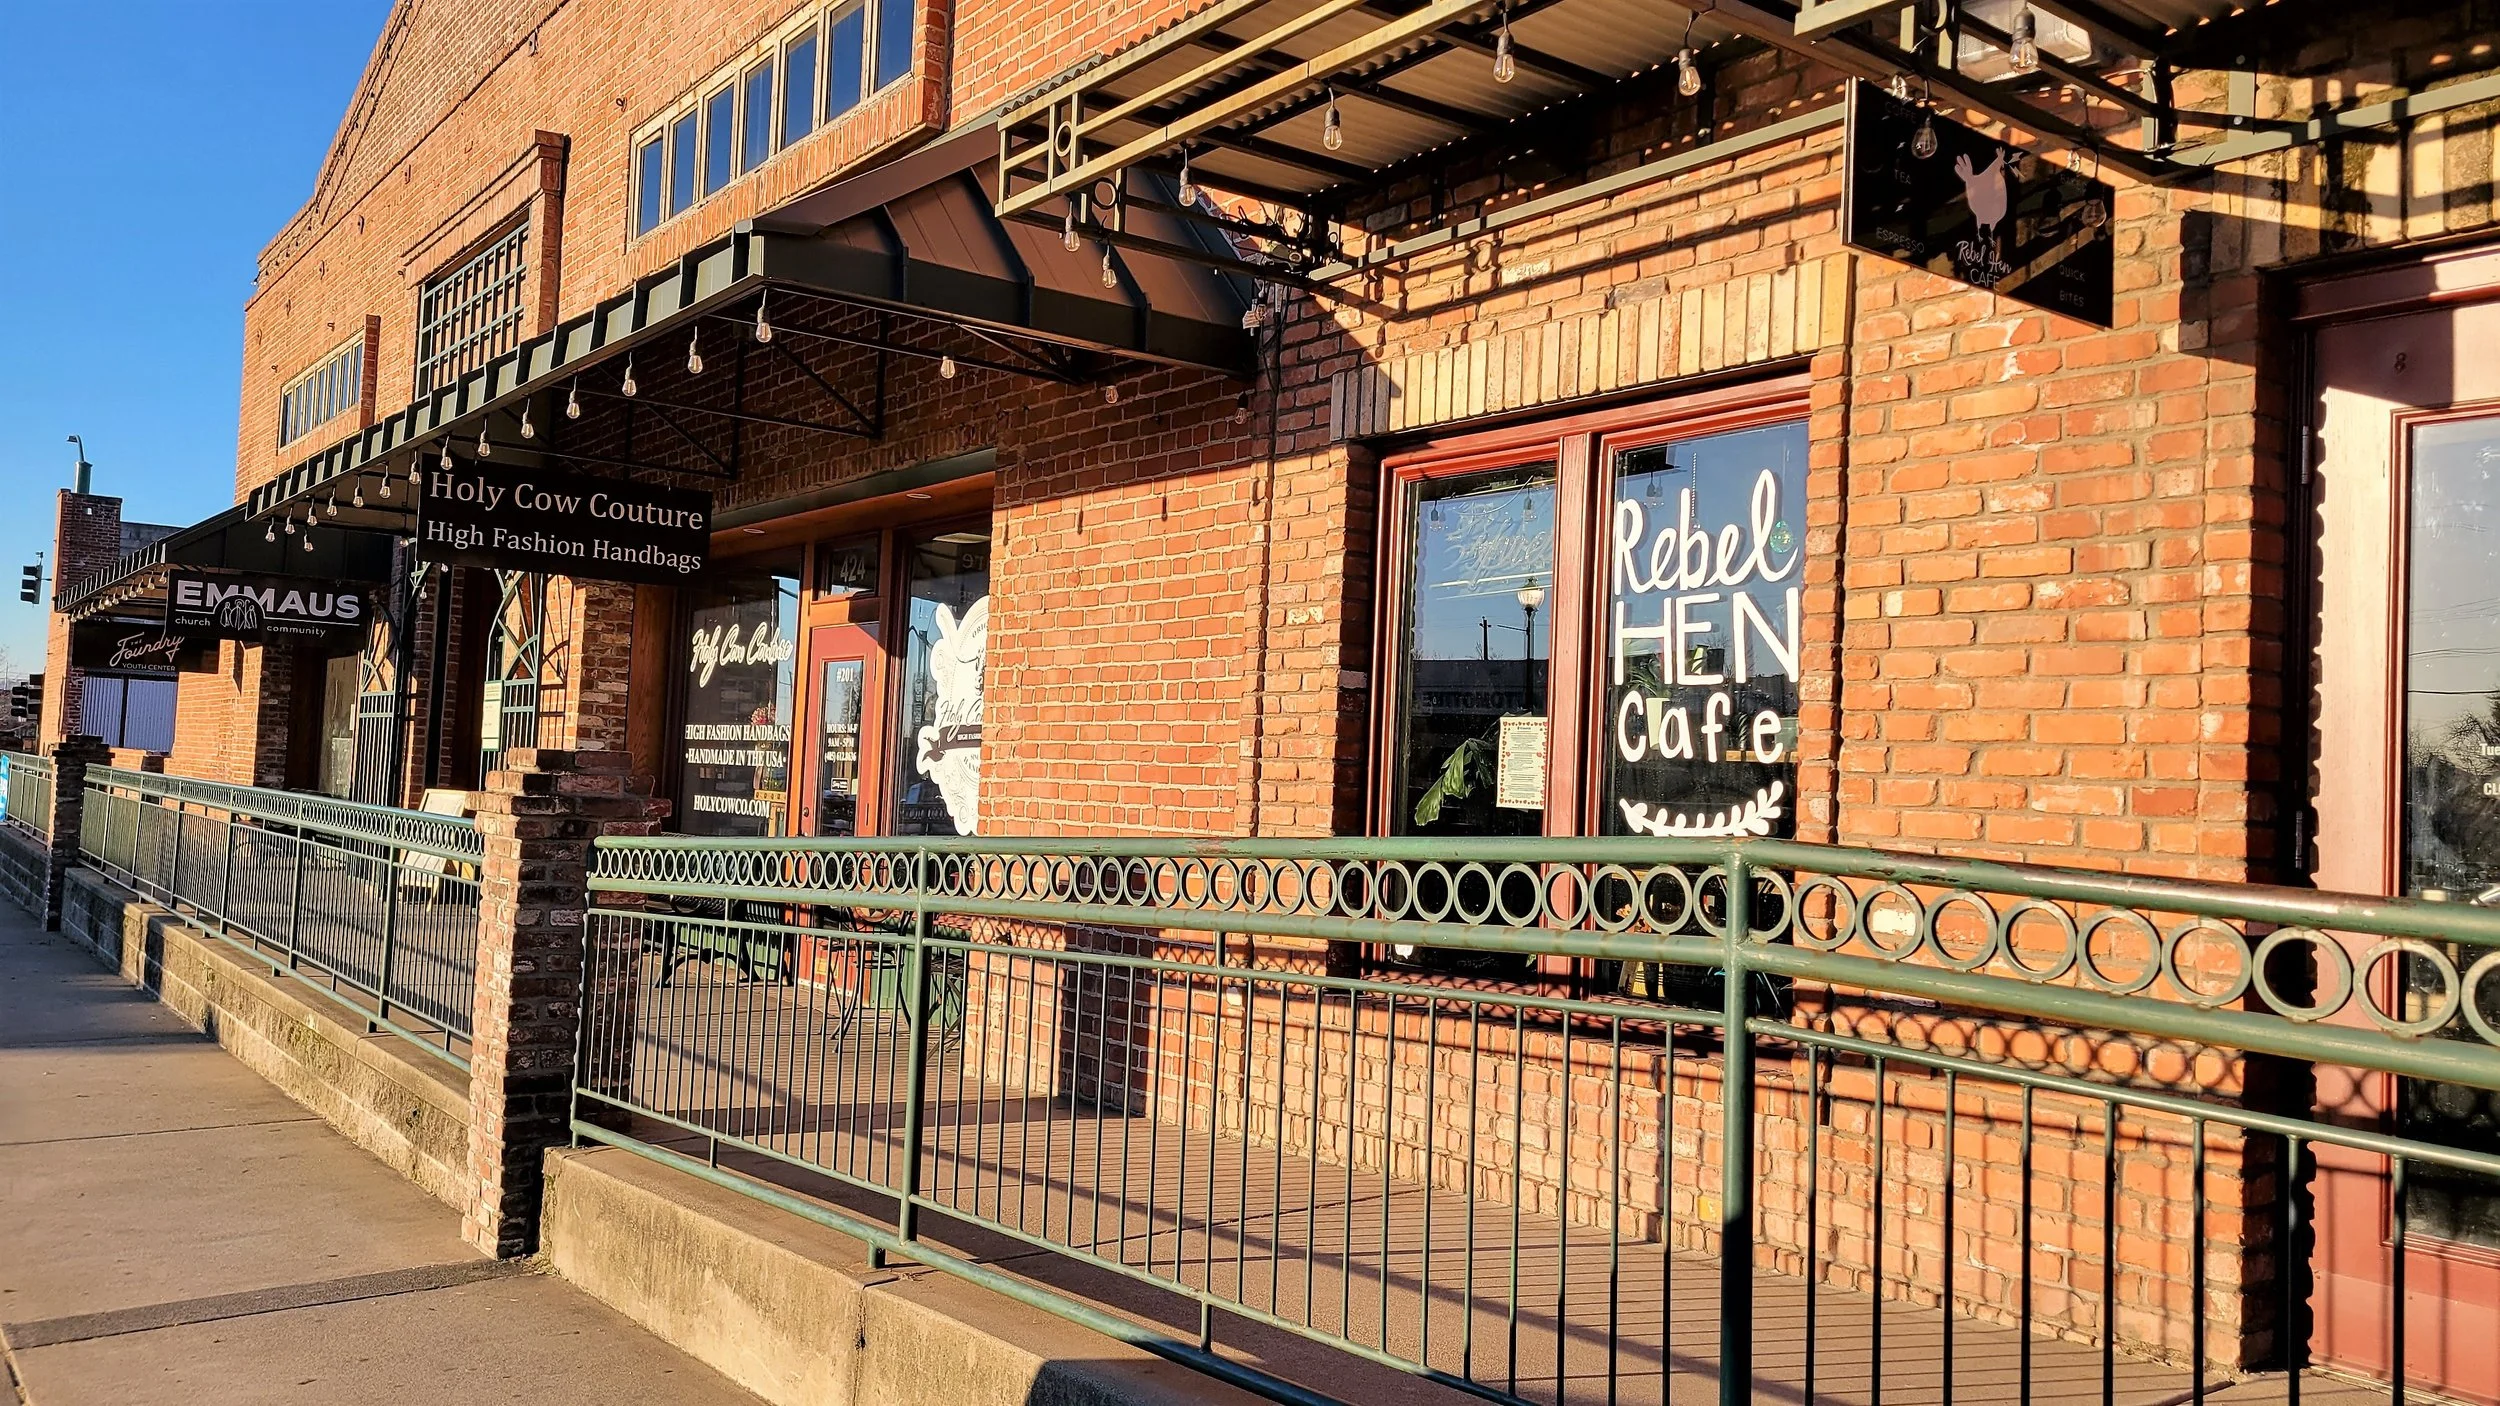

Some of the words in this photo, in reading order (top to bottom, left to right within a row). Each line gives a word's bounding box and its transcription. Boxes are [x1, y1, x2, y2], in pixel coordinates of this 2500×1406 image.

[1893, 169, 1912, 185] TEA
[1875, 226, 1925, 254] ESPRESSO
[1955, 240, 1987, 267] Rebel
[1988, 250, 2012, 274] Hen
[1970, 268, 2000, 292] CAFE
[2059, 264, 2086, 282] QUICK
[2059, 289, 2085, 308] BITES
[429, 471, 507, 511] Holy
[514, 483, 582, 515] Cow
[589, 493, 704, 530] Couture
[1614, 469, 1798, 596] Rebel
[426, 520, 485, 550] High
[492, 527, 586, 558] Fashion
[592, 538, 702, 574] Handbags
[840, 555, 866, 583] 424
[176, 580, 360, 619] EMMAUS
[174, 616, 211, 627] church
[266, 626, 327, 638] community
[1613, 587, 1800, 686] HEN
[109, 631, 185, 667] Foundry
[690, 625, 721, 688] Holy
[720, 624, 745, 666] Cow
[836, 667, 854, 682] #201
[684, 724, 706, 740] HIGH
[706, 724, 743, 741] FASHION
[743, 724, 791, 742] HANDBAGS
[940, 699, 964, 742] Holy
[1617, 690, 1784, 764] Cafe
[687, 748, 735, 766] HANDMADE
[735, 750, 746, 766] IN
[747, 750, 764, 767] THE
[765, 751, 784, 768] USA
[693, 795, 771, 818] HOLYCOWCO.COM
